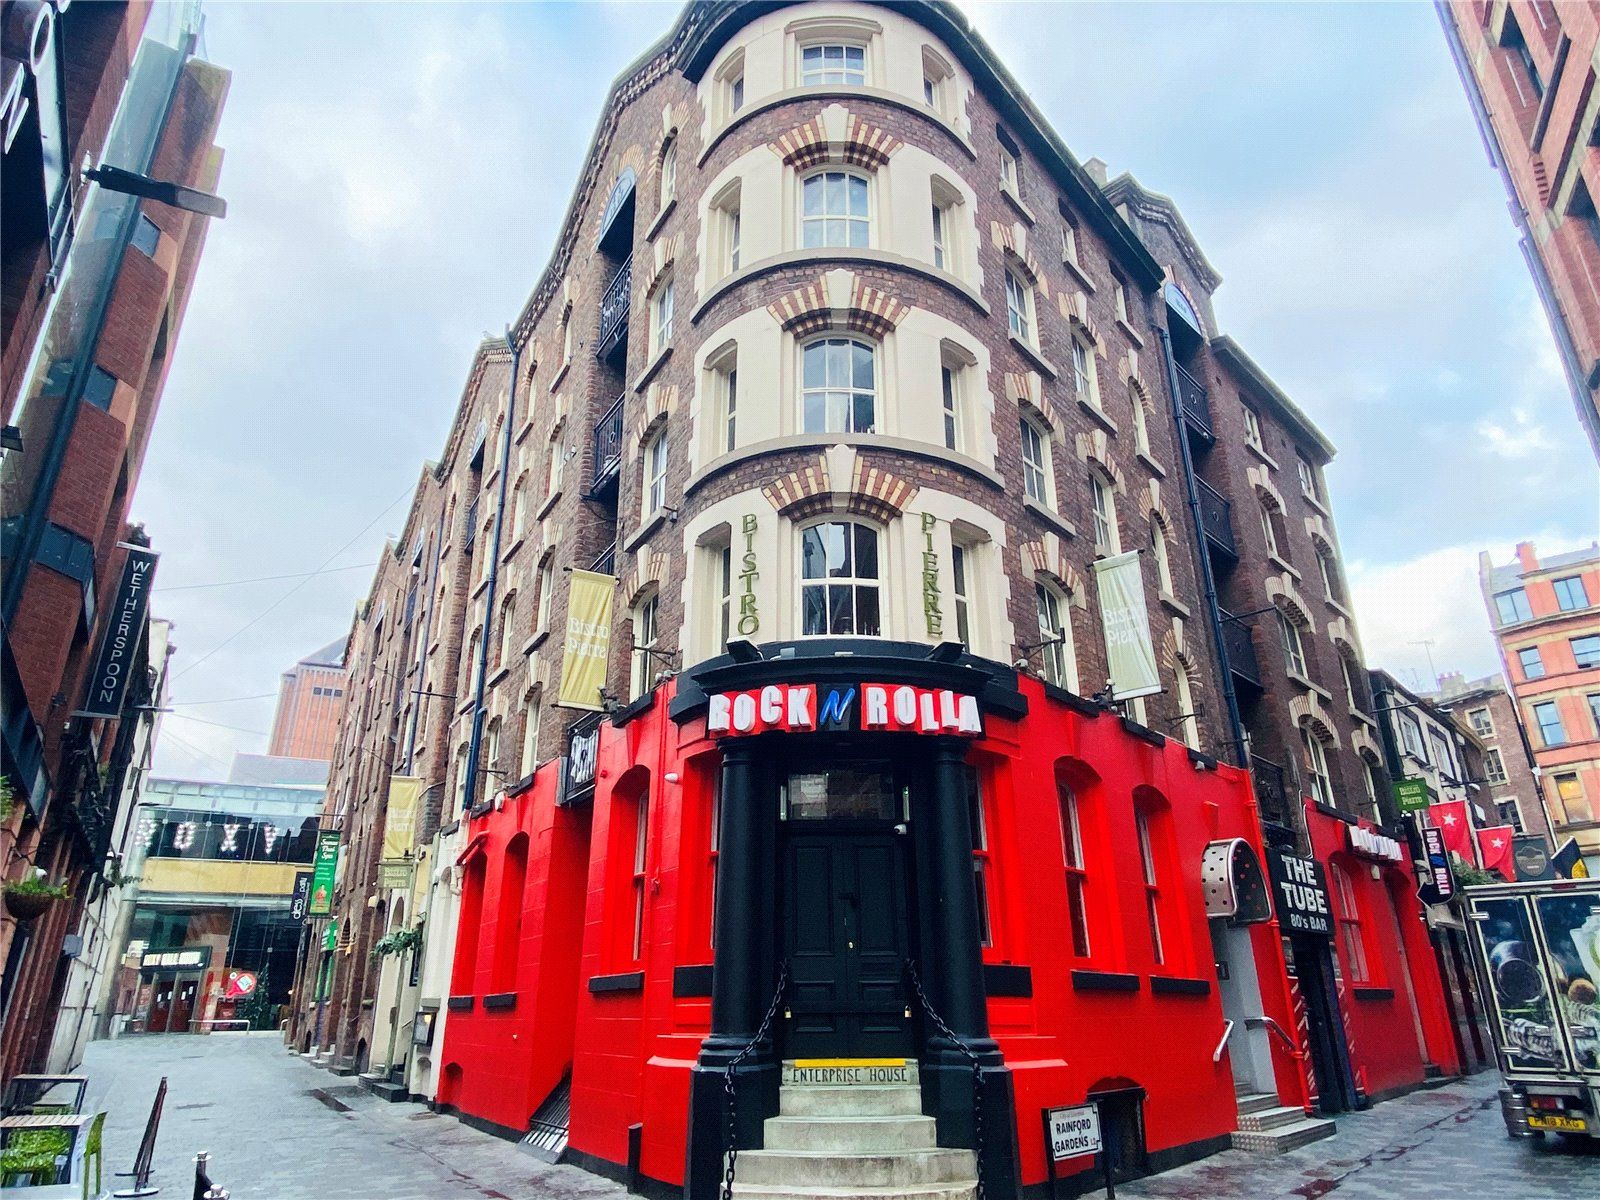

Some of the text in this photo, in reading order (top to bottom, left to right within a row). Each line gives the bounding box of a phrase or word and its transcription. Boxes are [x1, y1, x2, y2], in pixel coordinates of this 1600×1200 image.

[738, 513, 760, 636] BISTRO
[920, 511, 943, 637] PIERRE
[100, 560, 151, 703] WETHERSPOON
[708, 685, 982, 734] ROCK N ROLLA
[1280, 854, 1318, 886] THE
[1426, 831, 1442, 855] ROCK
[1434, 868, 1451, 895] ROLLA
[1280, 881, 1328, 914] TUBE
[1290, 914, 1328, 931] 80's BAR
[793, 1067, 908, 1083] ENTERPRISE HOUSE
[1055, 1118, 1092, 1135] RAINFORD
[1054, 1135, 1089, 1153] GARDENS
